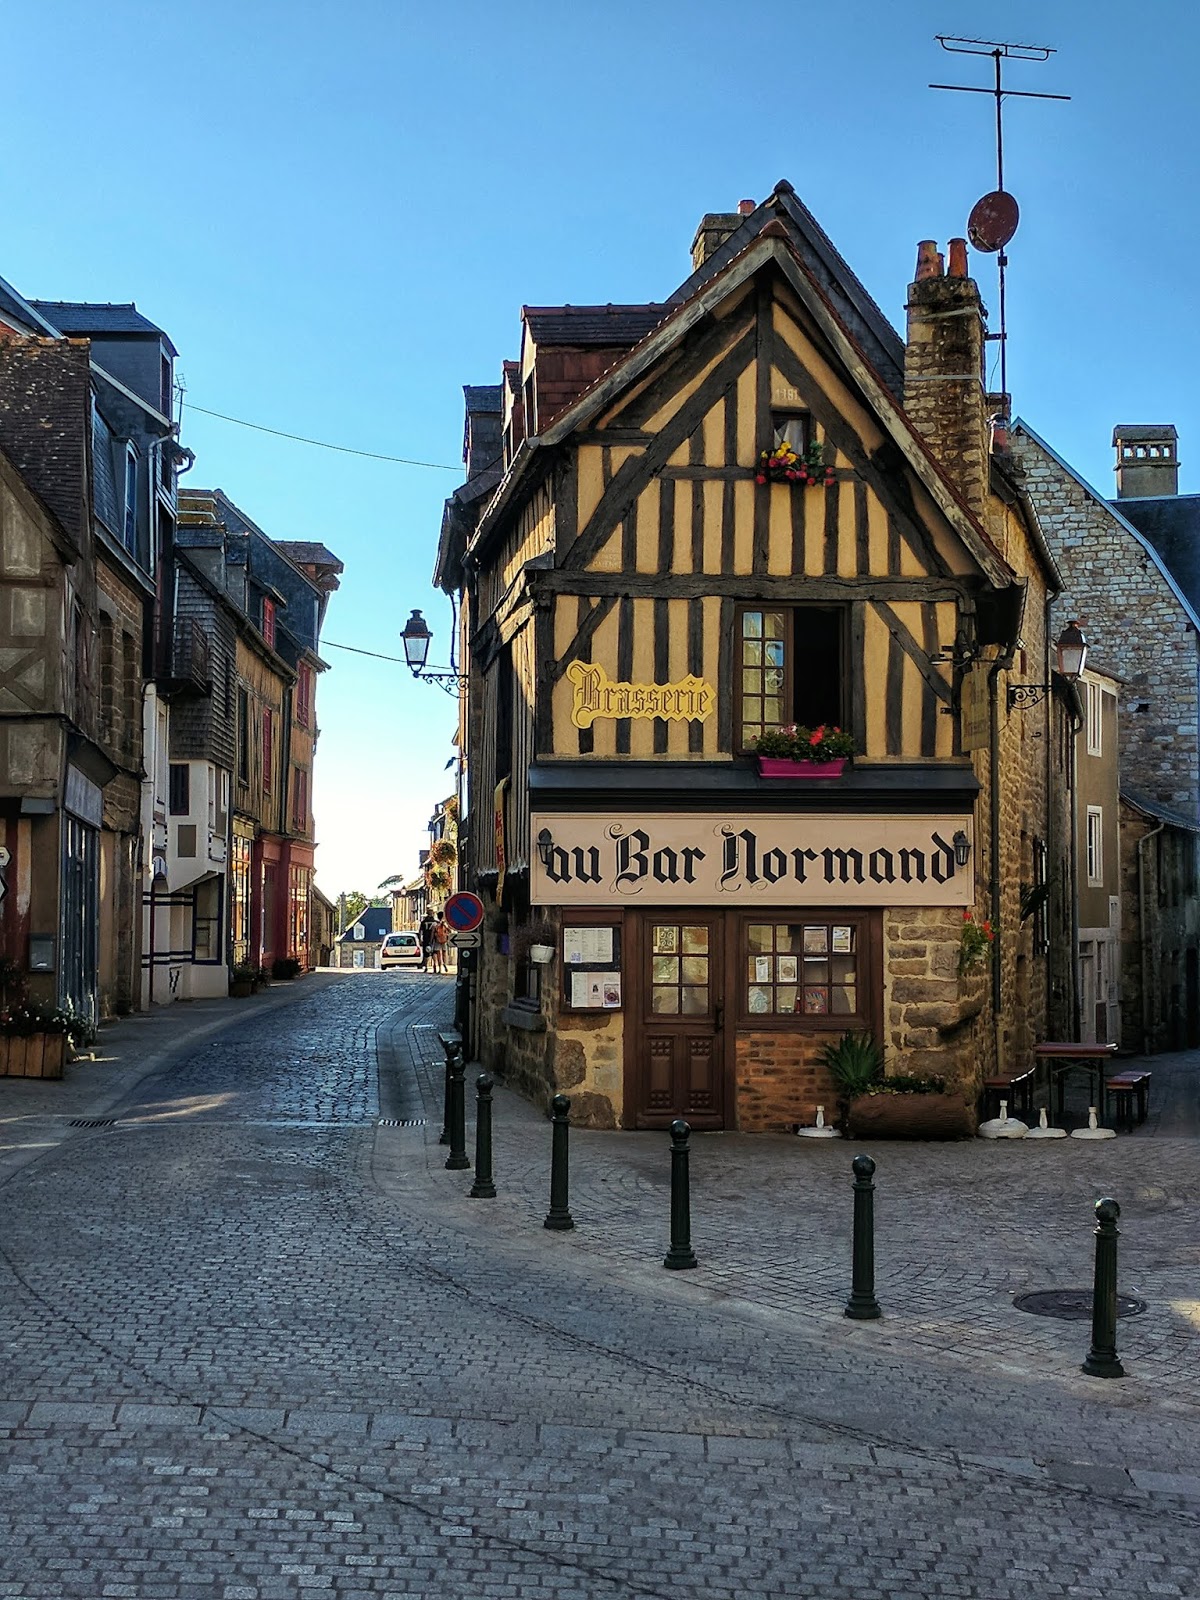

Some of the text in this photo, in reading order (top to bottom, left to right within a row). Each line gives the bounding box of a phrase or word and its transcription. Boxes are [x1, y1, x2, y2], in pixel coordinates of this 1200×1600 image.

[572, 663, 709, 719] Brasserie
[546, 822, 955, 895] au Bar Normand
